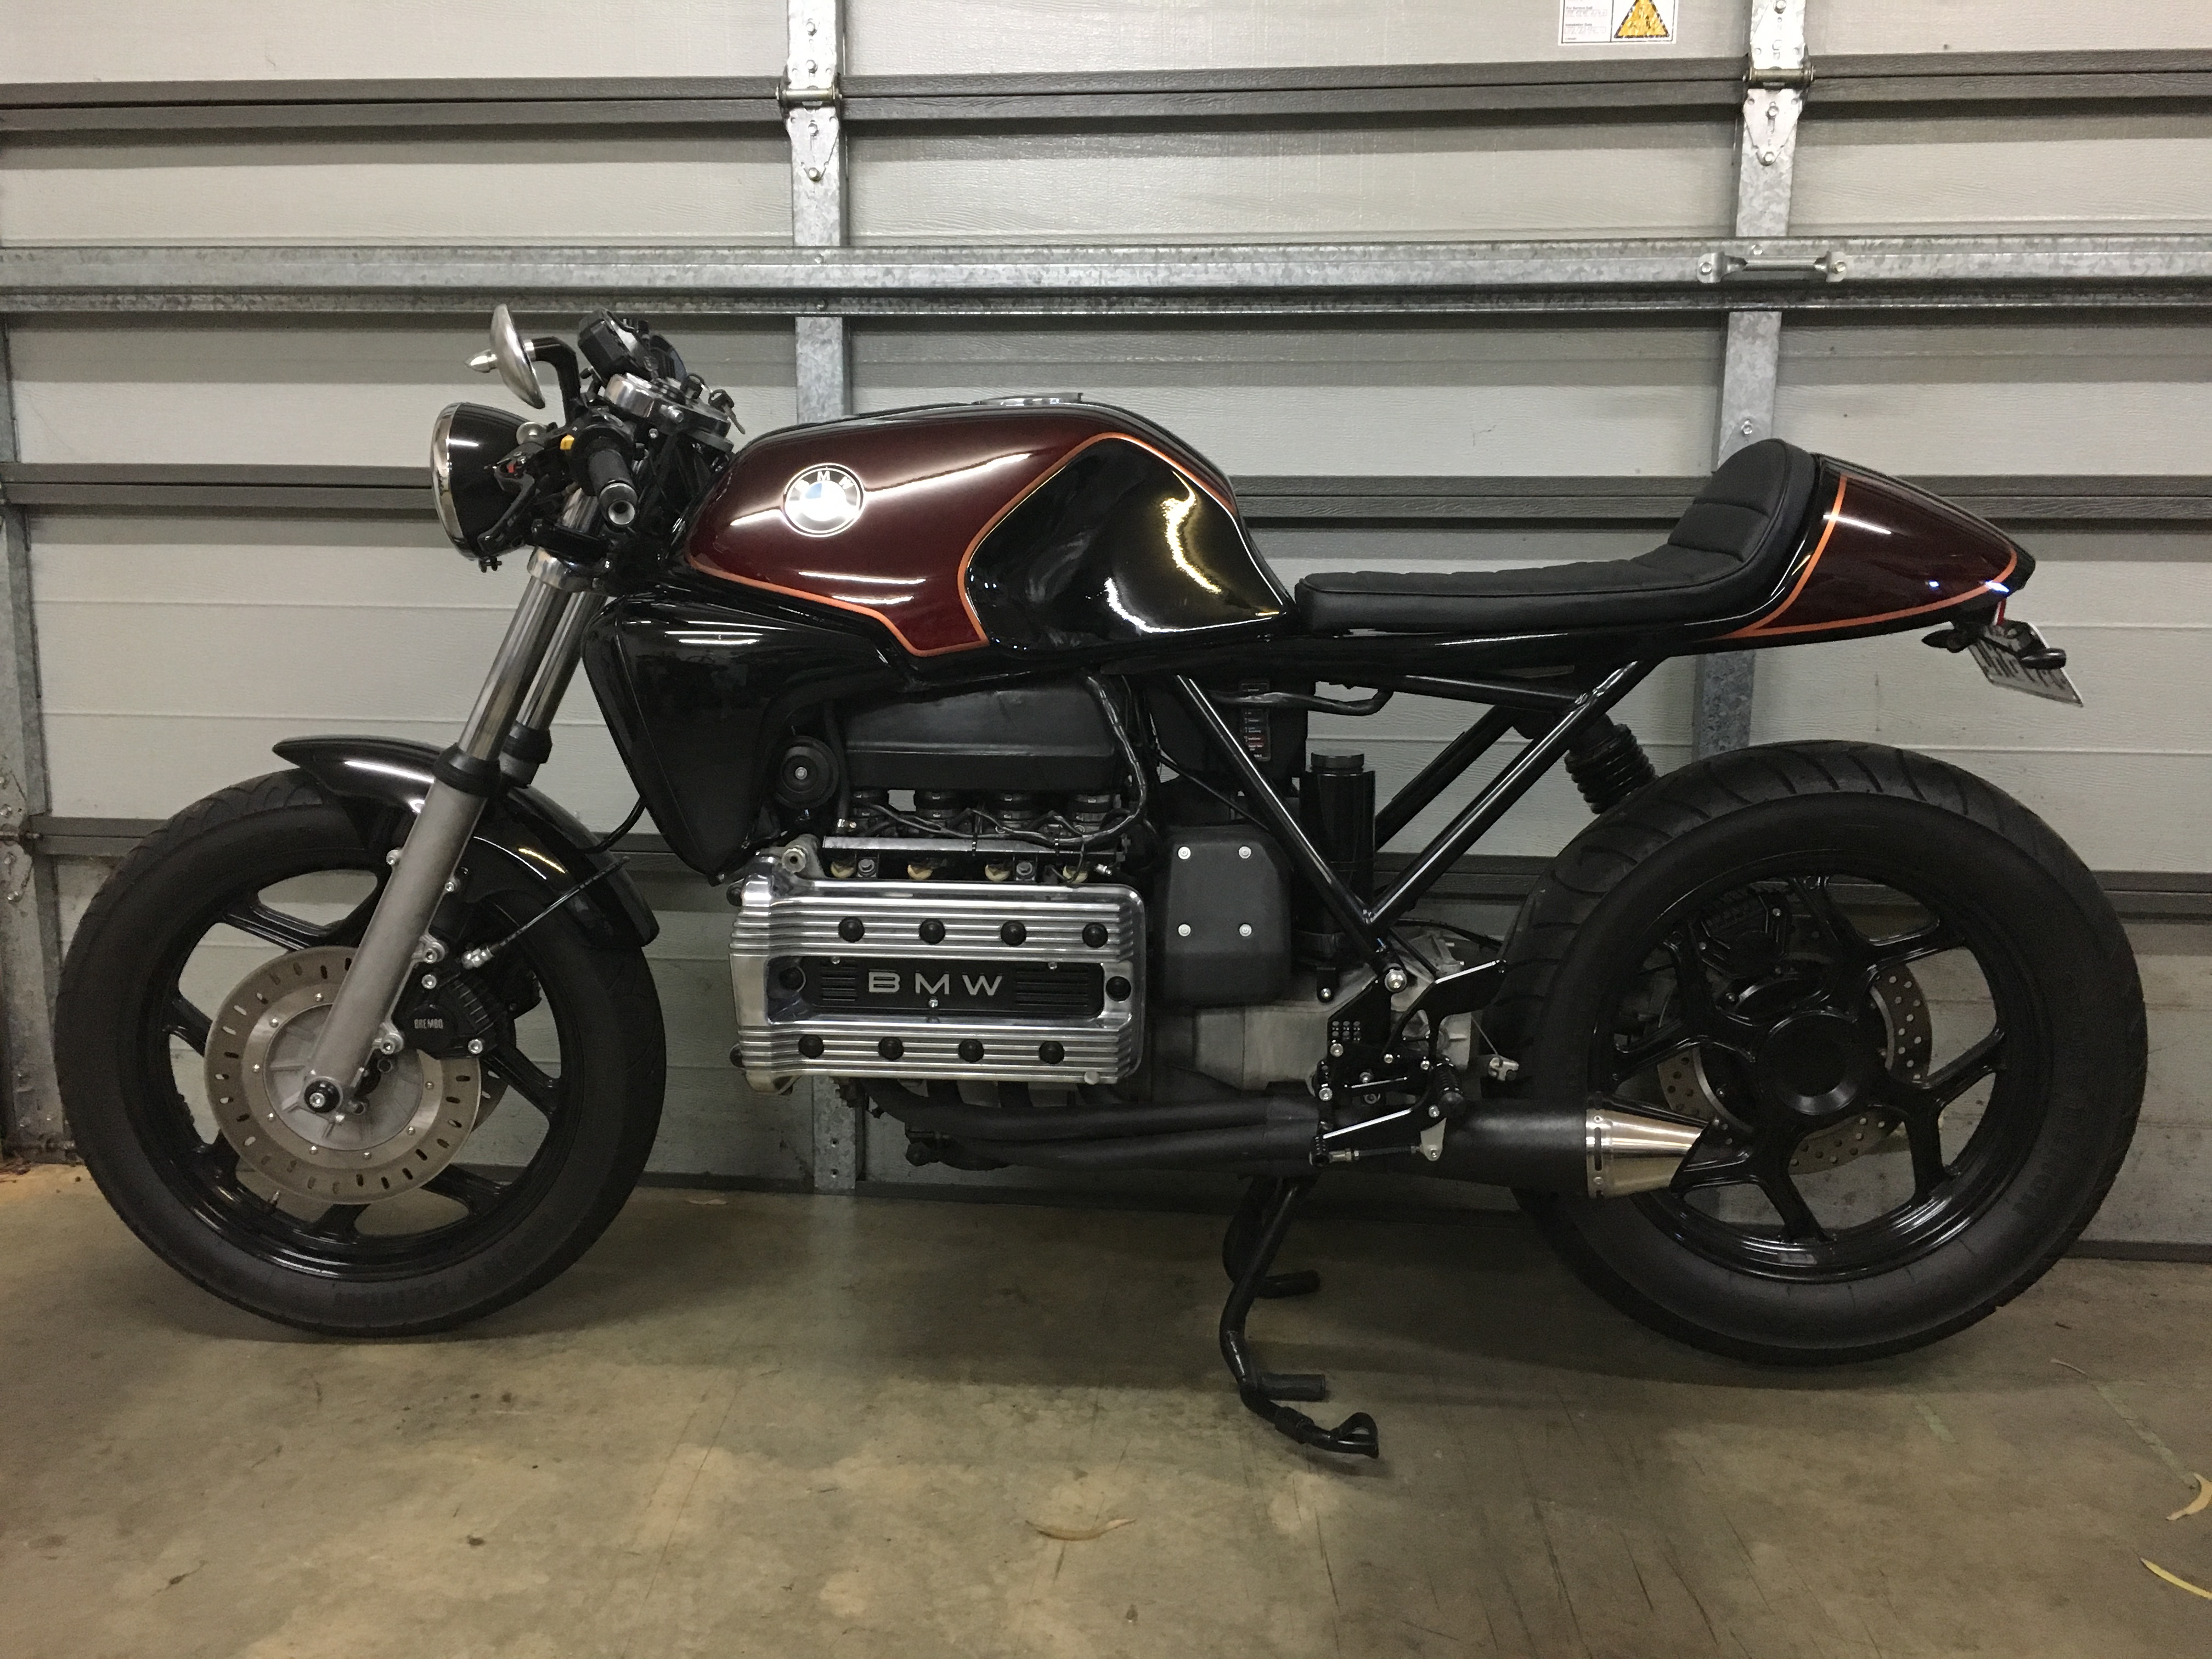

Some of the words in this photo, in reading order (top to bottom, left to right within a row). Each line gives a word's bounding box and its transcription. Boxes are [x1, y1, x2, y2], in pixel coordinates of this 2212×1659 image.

[794, 470, 854, 492] BMW
[868, 972, 1002, 995] BMW
[414, 1019, 443, 1029] BREMBO
